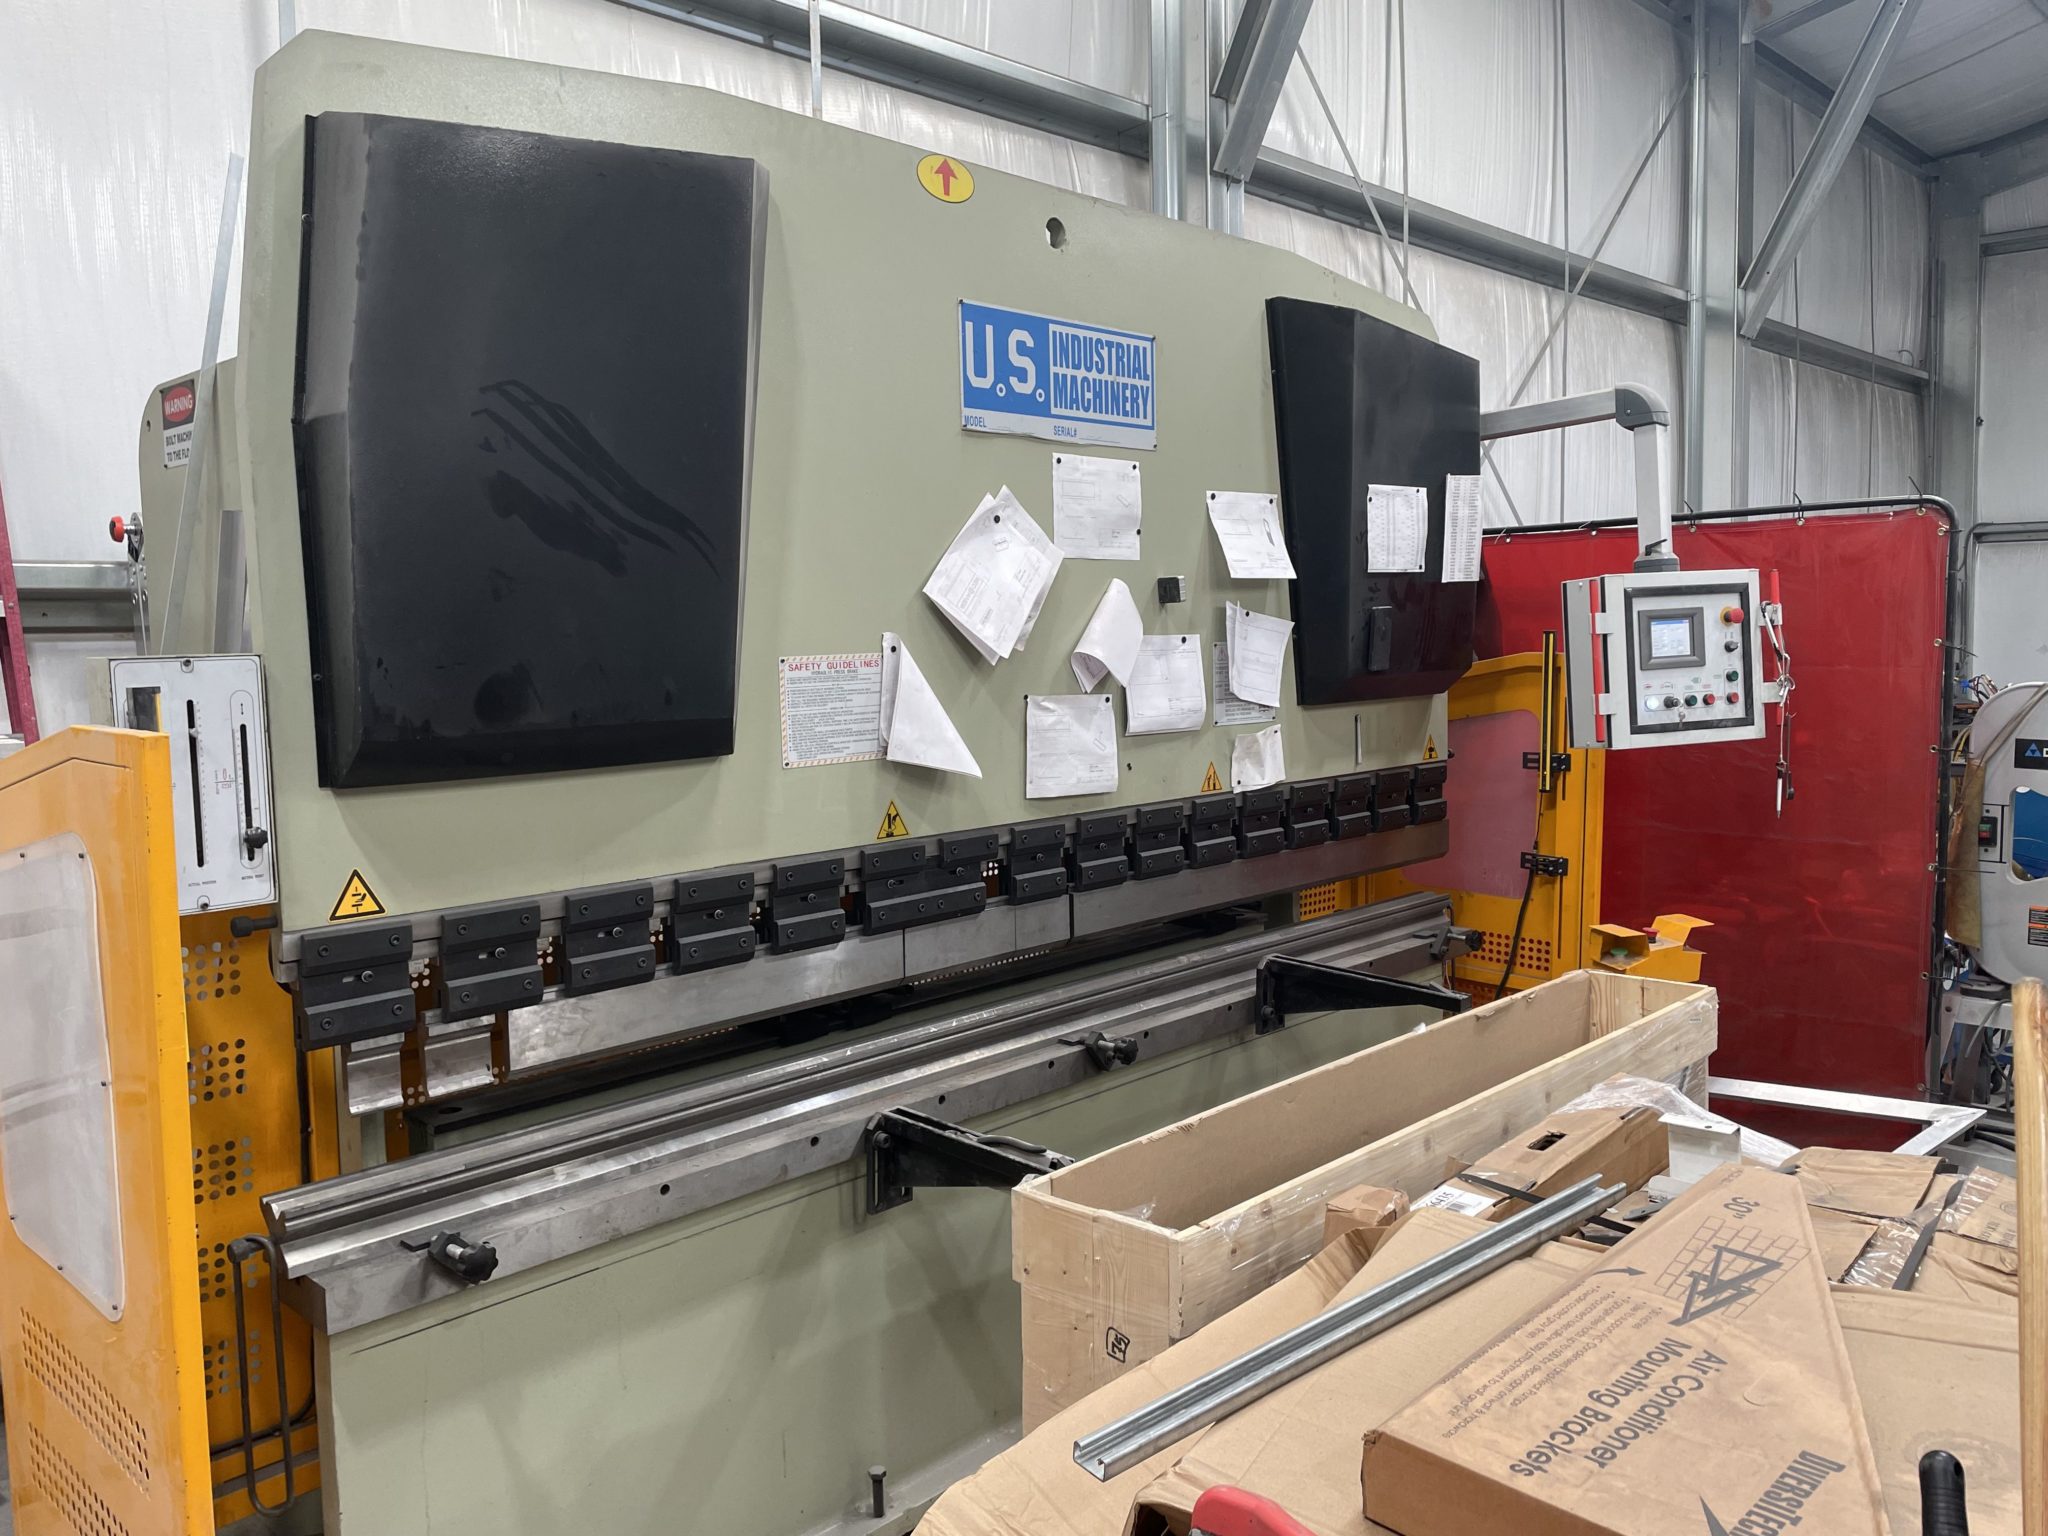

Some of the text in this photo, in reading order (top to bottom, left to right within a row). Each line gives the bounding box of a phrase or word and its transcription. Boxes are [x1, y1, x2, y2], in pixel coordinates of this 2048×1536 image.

[964, 320, 1045, 402] U.S.
[1052, 330, 1150, 382] INDUSTRIAL
[164, 394, 193, 416] WARNING
[1052, 371, 1150, 420] MACHINERY
[963, 415, 987, 428] MODEL
[1053, 425, 1078, 438] SERIAL#
[165, 434, 177, 447] BOLT
[166, 451, 173, 462] TO
[173, 449, 182, 461] THE
[788, 660, 880, 672] SAFETY GUIDELINES
[1509, 1337, 1693, 1477] Mounting Brackets
[1583, 1349, 1728, 1469] Air Conditioner
